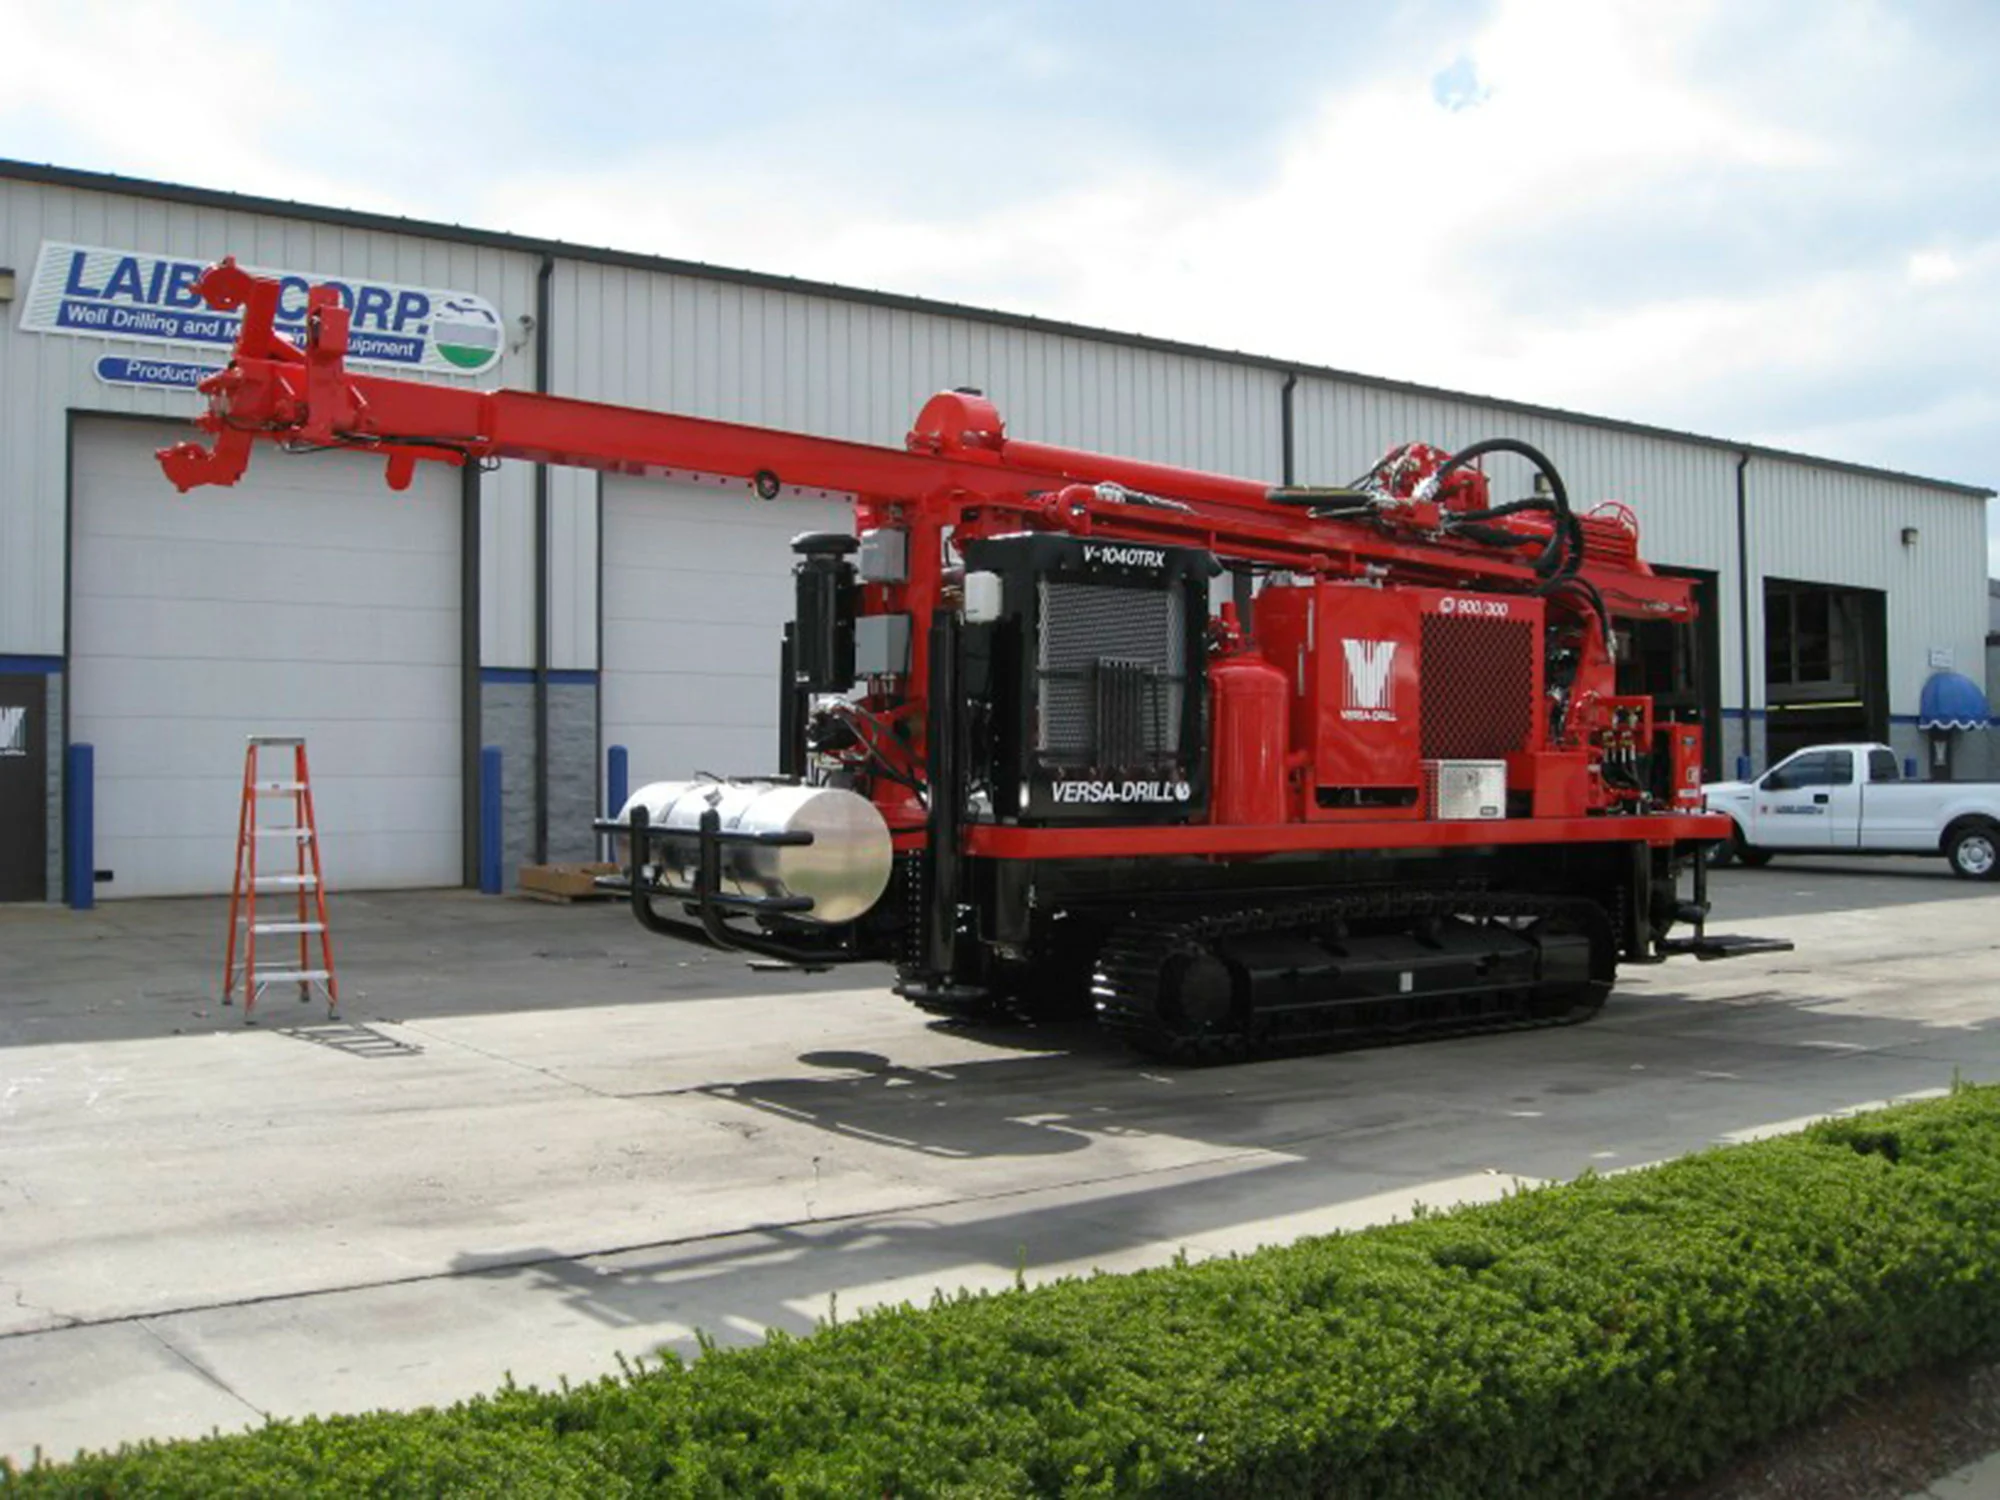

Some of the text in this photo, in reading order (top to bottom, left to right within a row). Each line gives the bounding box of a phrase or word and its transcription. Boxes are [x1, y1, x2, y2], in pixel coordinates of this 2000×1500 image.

[65, 251, 238, 313] LAIB
[67, 304, 108, 323] Well
[112, 309, 178, 336] Drilling
[183, 320, 218, 336] and
[347, 335, 416, 357] uipment
[1083, 545, 1165, 567] V-1040TRX
[1052, 781, 1175, 802] VERSA-DRILL
